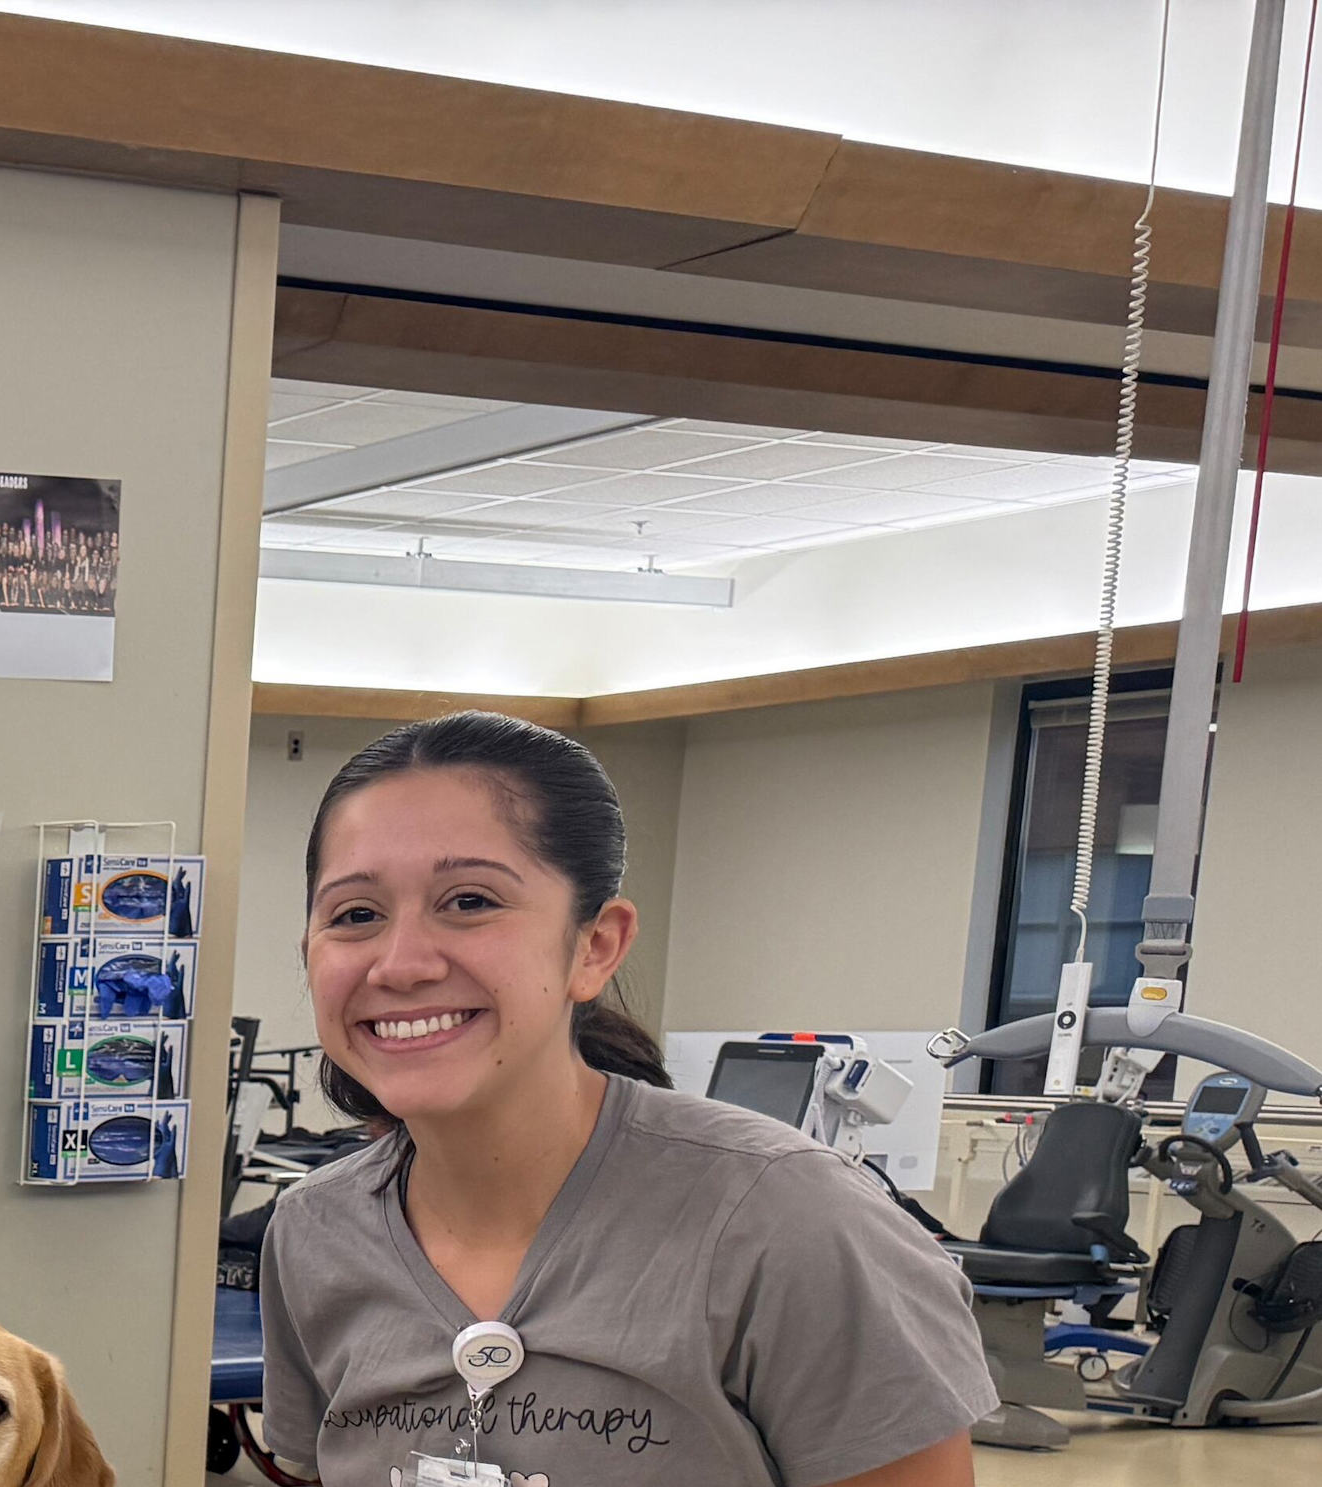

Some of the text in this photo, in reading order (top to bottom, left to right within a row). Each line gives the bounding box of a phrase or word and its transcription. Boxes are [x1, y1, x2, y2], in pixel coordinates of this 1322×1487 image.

[80, 886, 92, 903] S
[73, 971, 88, 987] M
[65, 1051, 76, 1070] L
[507, 1391, 670, 1454] therapy
